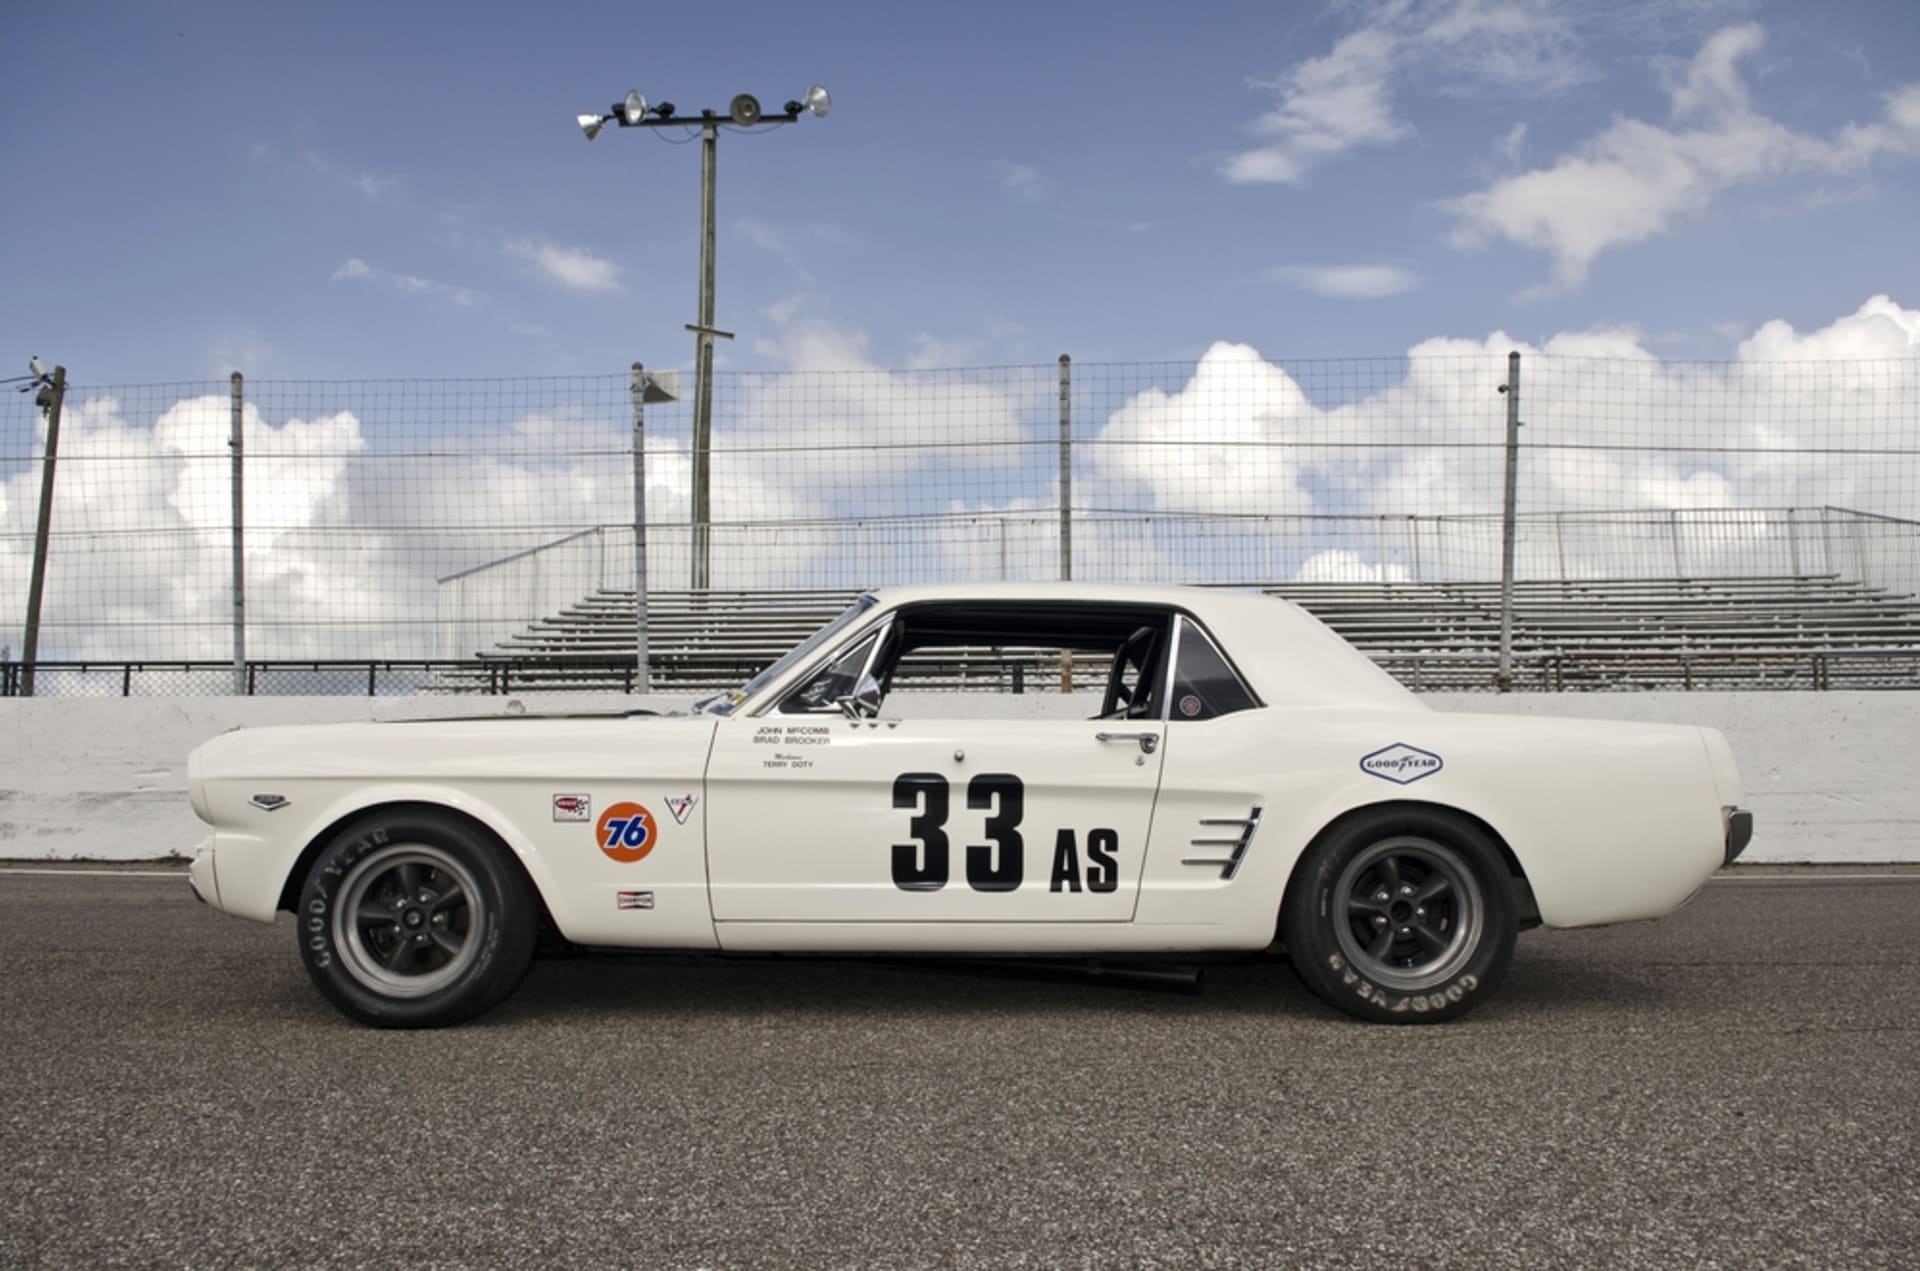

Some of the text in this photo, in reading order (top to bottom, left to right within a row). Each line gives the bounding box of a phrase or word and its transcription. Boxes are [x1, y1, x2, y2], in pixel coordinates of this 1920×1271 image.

[753, 736, 830, 744] BRAD BROOKER
[757, 727, 782, 735] JOHN
[604, 815, 647, 848] 76
[891, 772, 1118, 893] 33 AS
